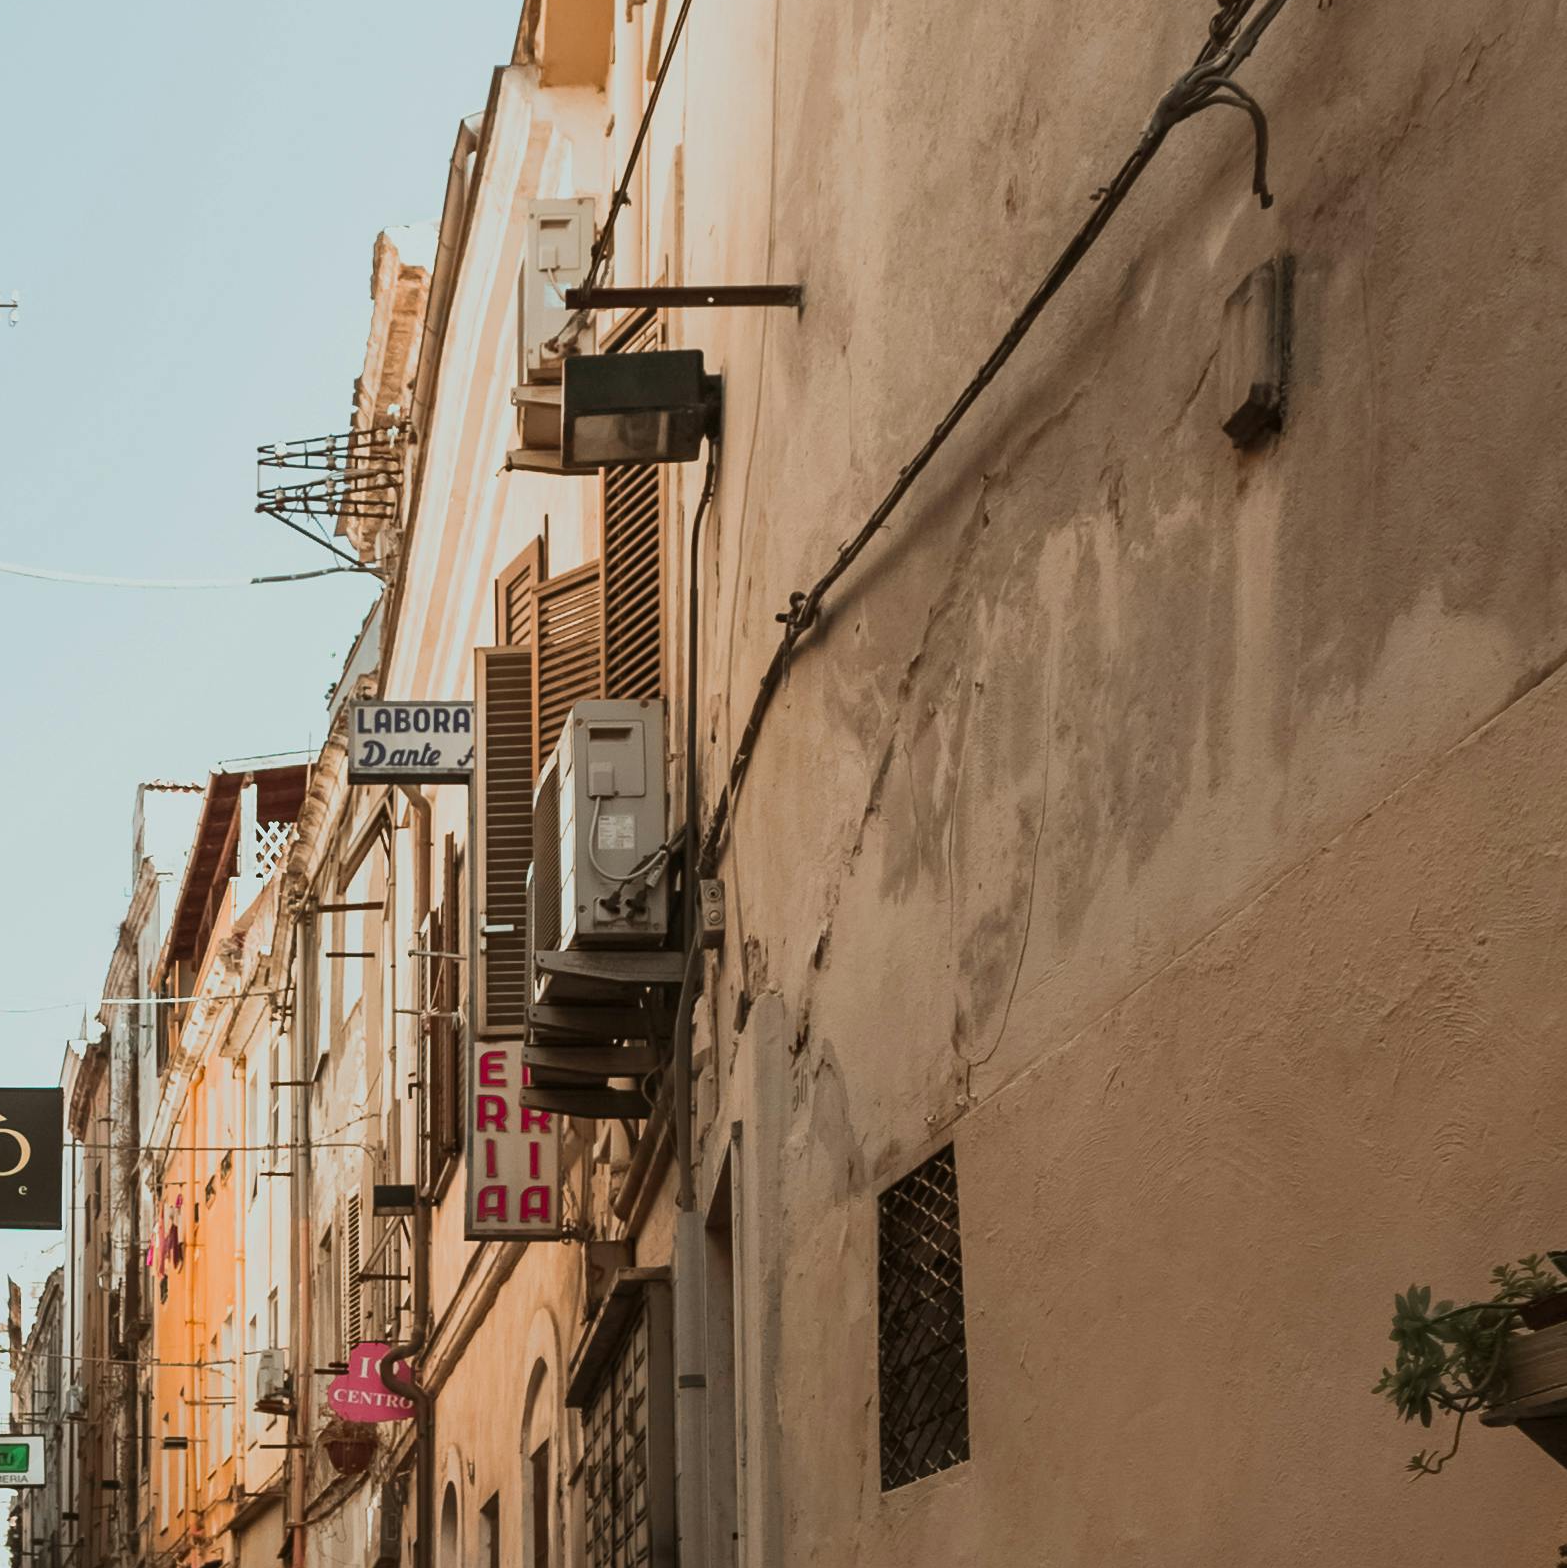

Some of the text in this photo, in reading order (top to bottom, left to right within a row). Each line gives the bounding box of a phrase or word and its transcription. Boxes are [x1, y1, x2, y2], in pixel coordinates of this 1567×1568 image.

[357, 708, 474, 733] LABORA
[359, 740, 441, 766] Dante
[360, 1357, 370, 1378] I
[333, 1388, 414, 1409] CENTRO
